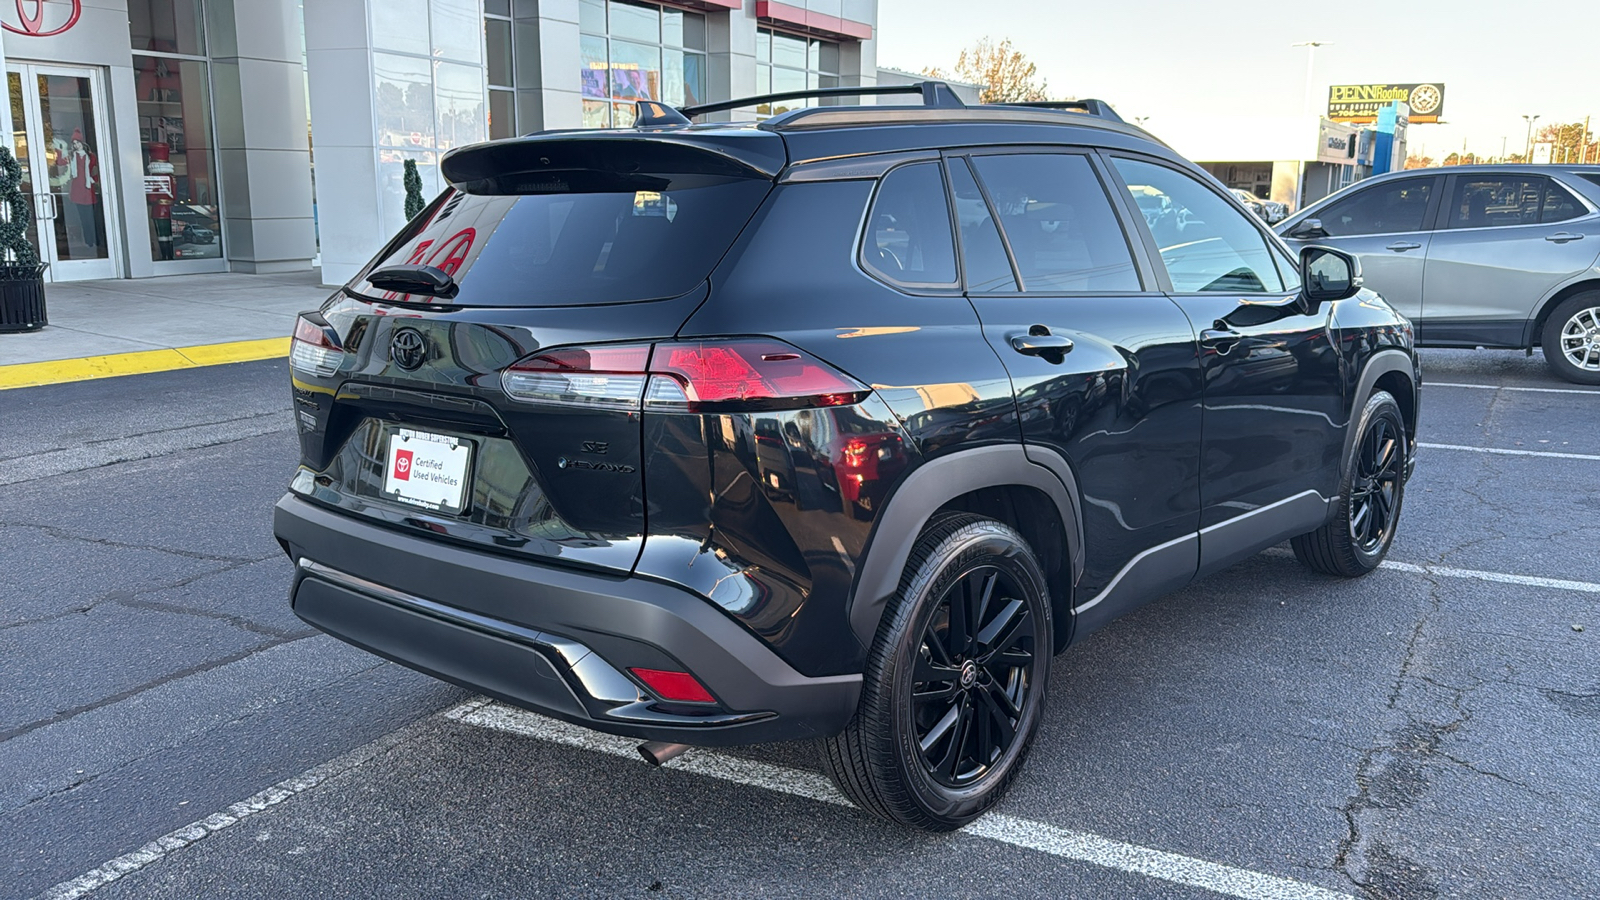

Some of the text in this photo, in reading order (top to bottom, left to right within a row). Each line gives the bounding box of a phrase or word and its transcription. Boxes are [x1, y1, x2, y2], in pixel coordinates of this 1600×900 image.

[1330, 85, 1379, 100] PENN
[1376, 86, 1409, 101] Roofing
[581, 440, 609, 455] SE
[415, 457, 443, 470] Certified
[413, 470, 458, 486] Used Vehicles
